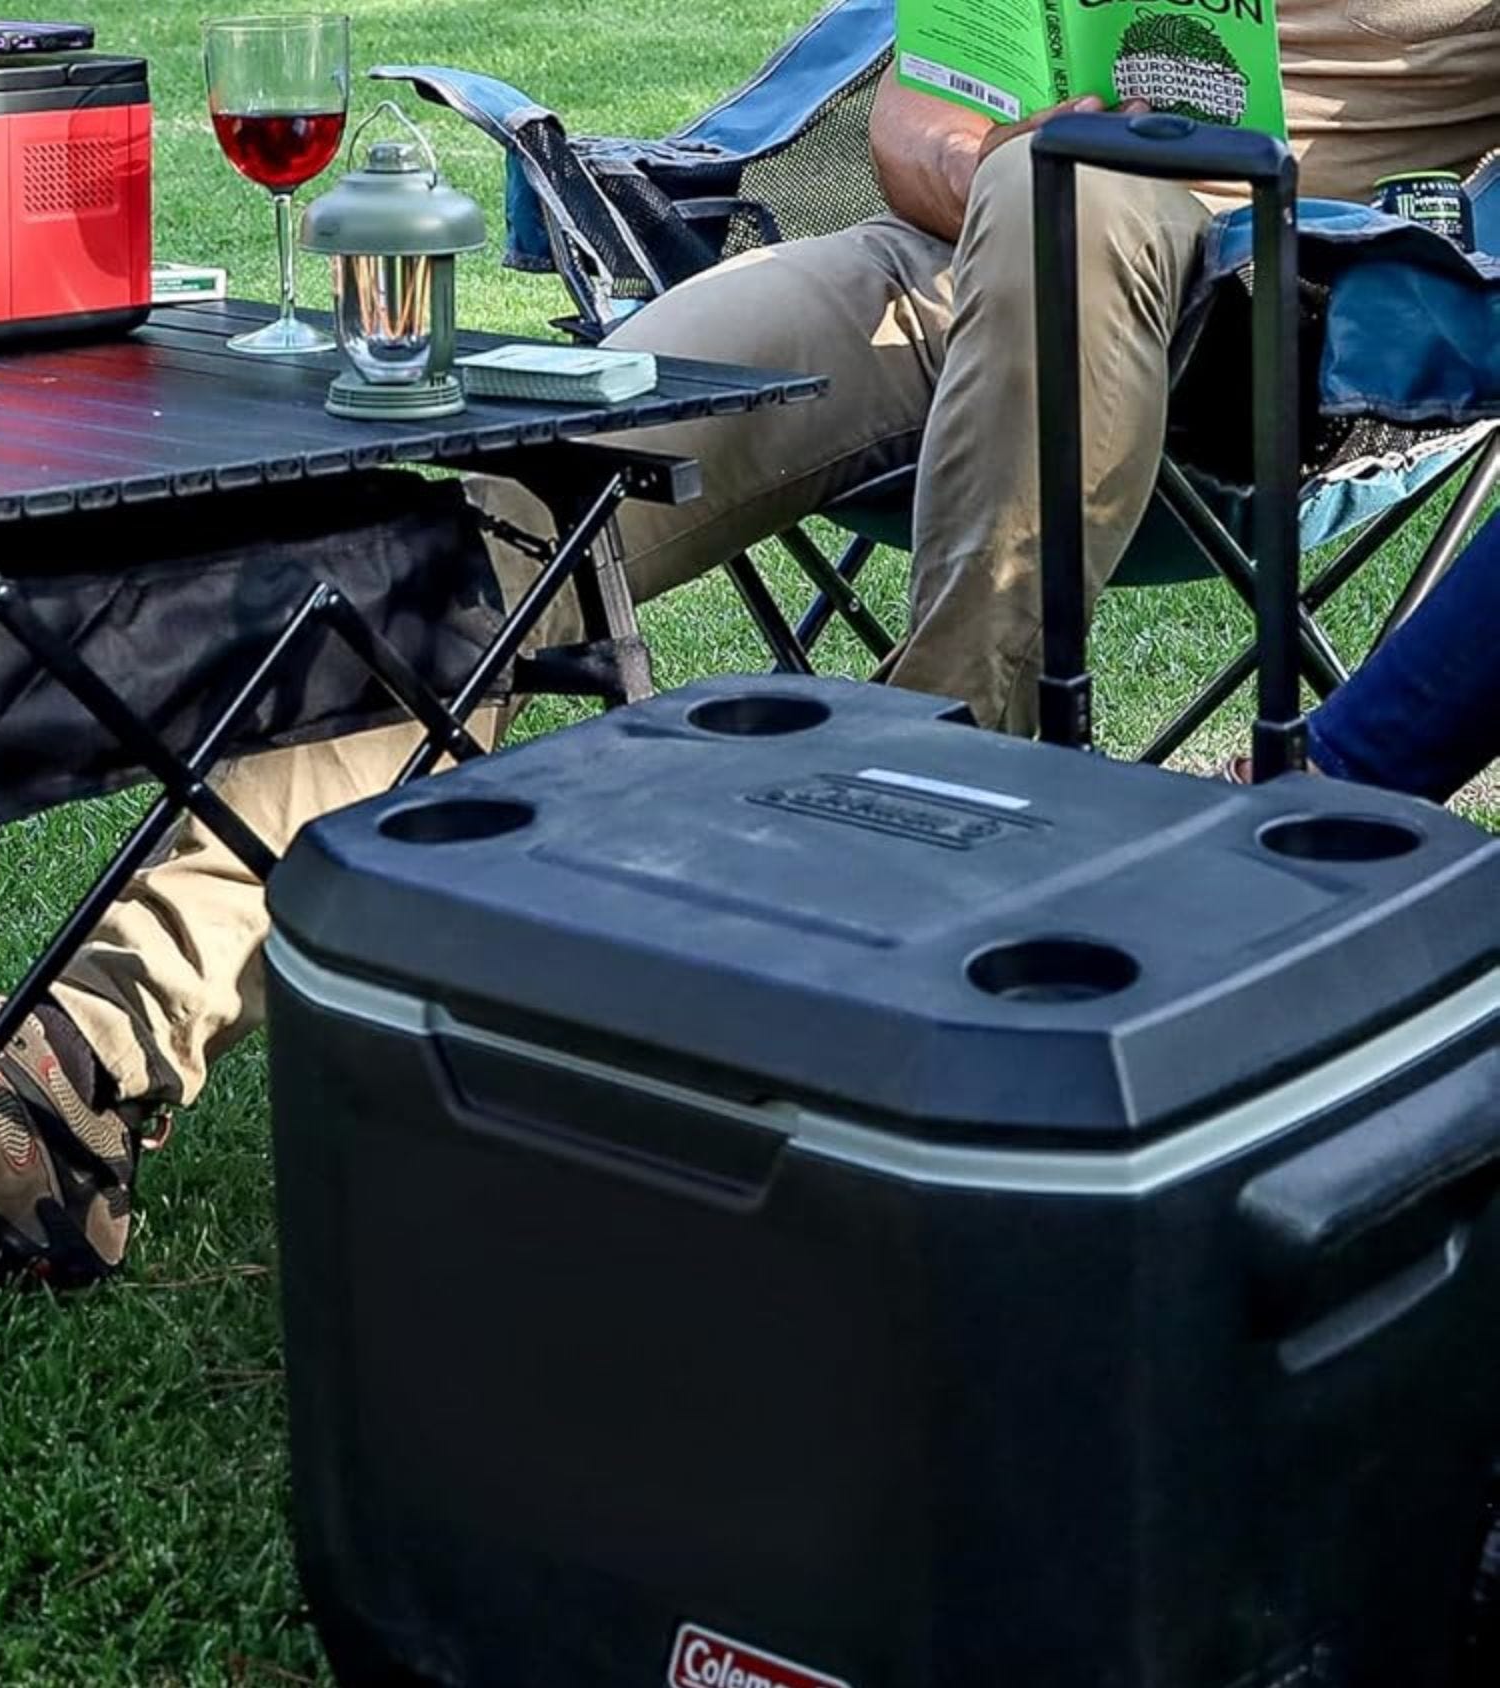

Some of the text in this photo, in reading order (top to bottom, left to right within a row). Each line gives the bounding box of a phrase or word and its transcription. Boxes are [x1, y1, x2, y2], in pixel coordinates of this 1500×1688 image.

[1115, 73, 1242, 98] NEUROMANCER
[1118, 85, 1244, 110] NEUROMANCER
[684, 1639, 790, 1688] Colem
